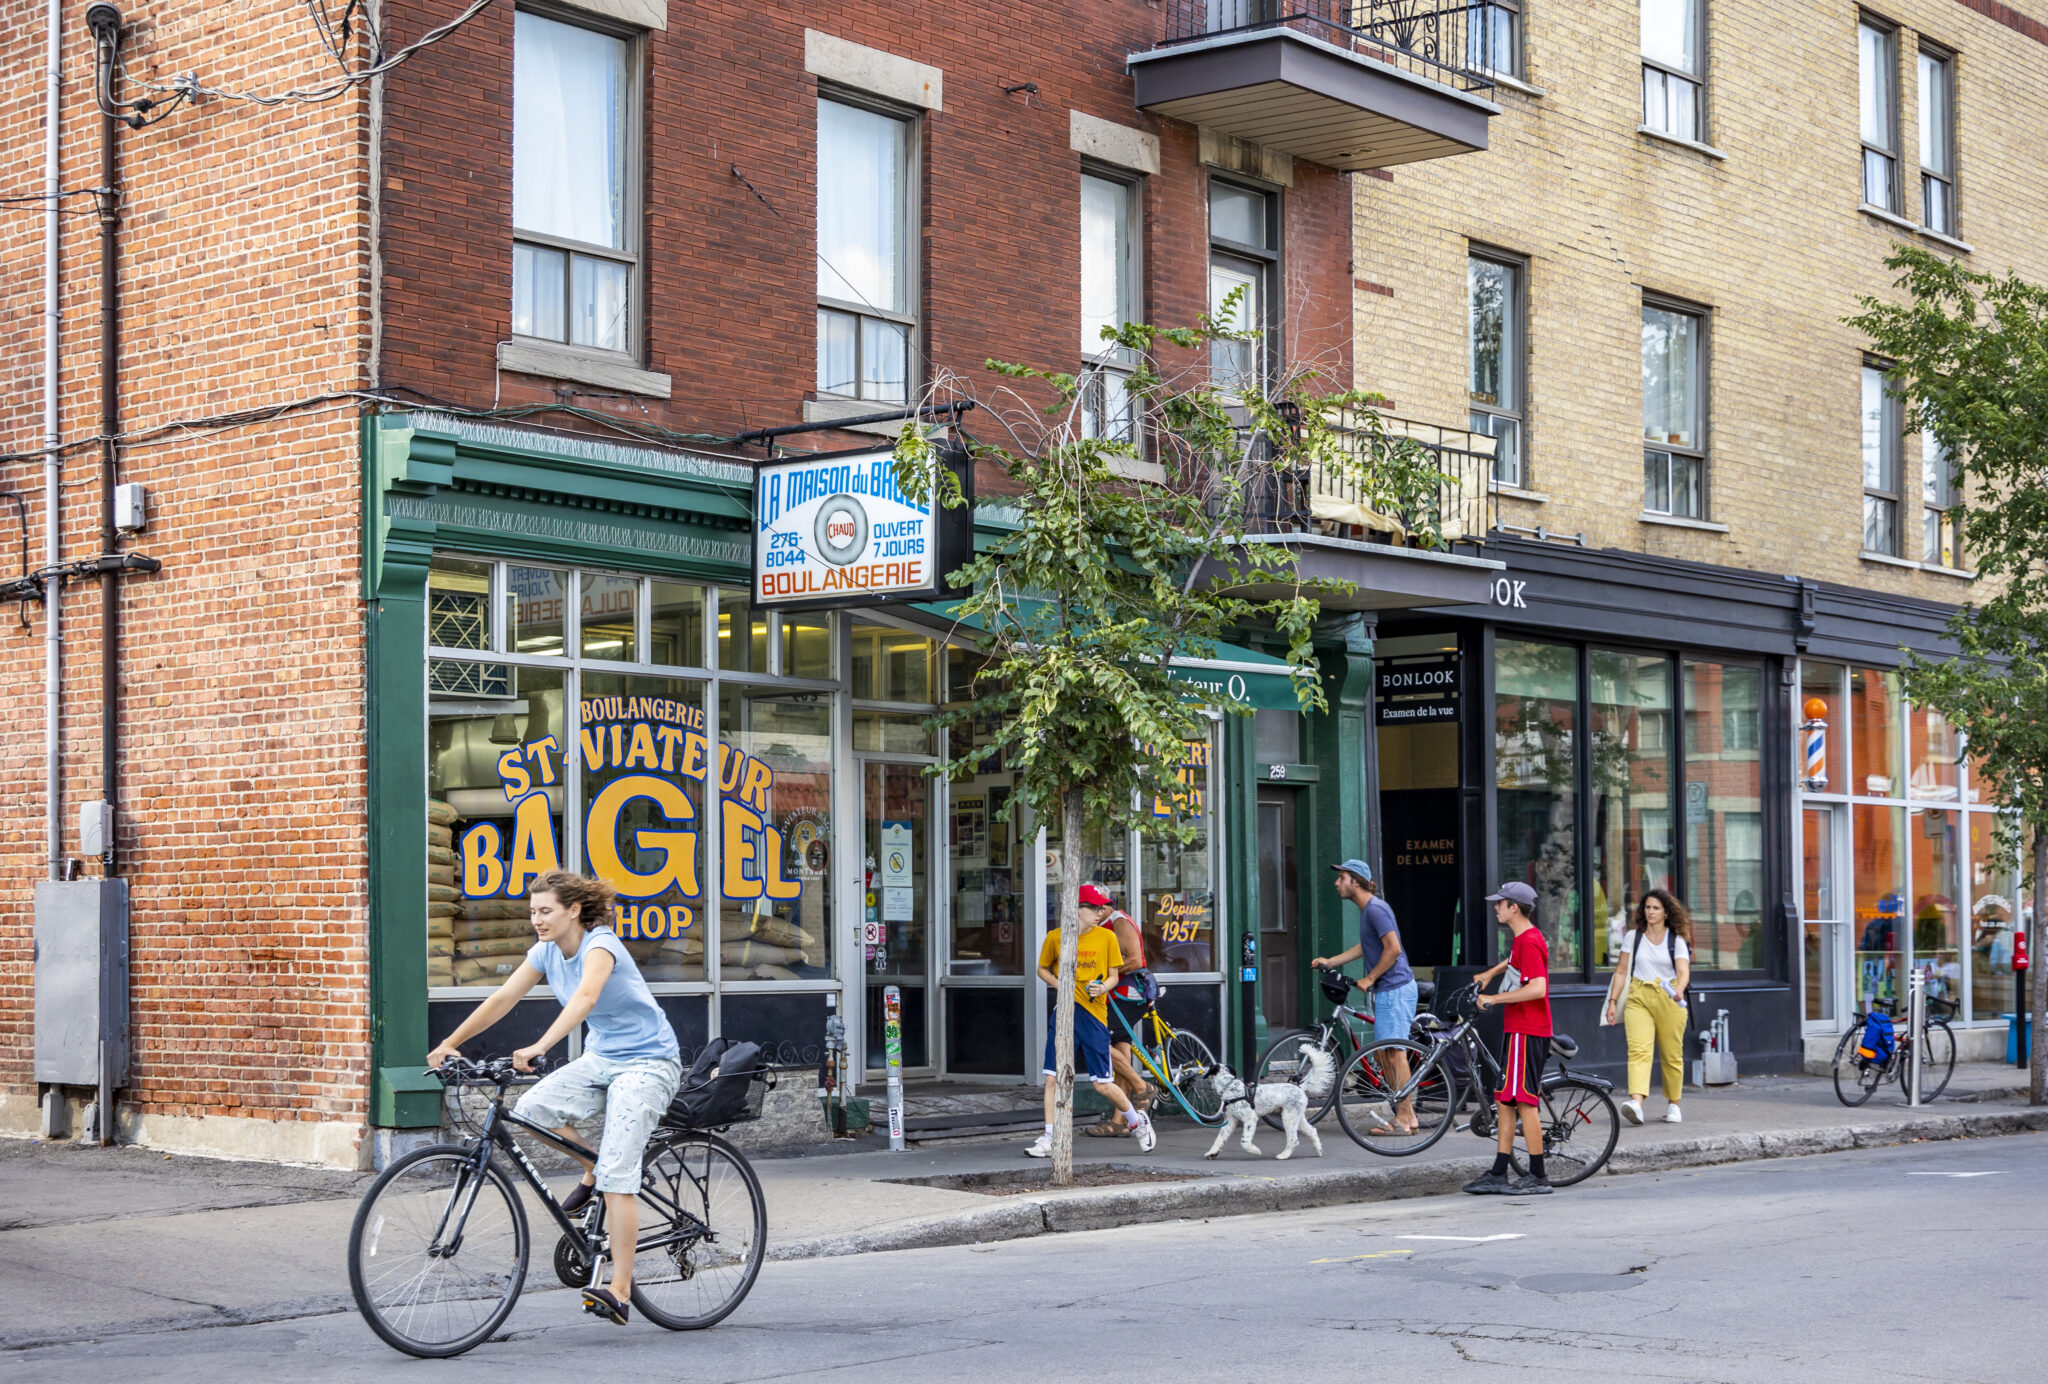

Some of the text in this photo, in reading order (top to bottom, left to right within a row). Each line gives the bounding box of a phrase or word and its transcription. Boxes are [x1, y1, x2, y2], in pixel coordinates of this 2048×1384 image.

[761, 459, 930, 532] LA MAISON du BAG
[827, 522, 855, 539] CHAUD
[873, 519, 923, 539] OUVERT
[771, 532, 803, 549] 276-
[873, 538, 925, 558] 7 JOURS
[766, 549, 806, 568] 8044
[762, 561, 922, 596] BOULANGERIE
[1490, 578, 1527, 608] OK
[1382, 670, 1454, 687] BONLOOK
[580, 696, 705, 730] BOULANGERIE
[1383, 705, 1454, 719] Examen de la vue
[1144, 742, 1212, 768] OERT
[1270, 765, 1285, 778] 259
[460, 772, 803, 900] BAGEL
[1406, 840, 1454, 850] EXAMEN
[1397, 854, 1454, 865] DE LA VUE
[1157, 894, 1209, 919] Depuis
[607, 903, 695, 940] HOP
[1161, 920, 1200, 943] 1957
[512, 1139, 553, 1200] TREK
